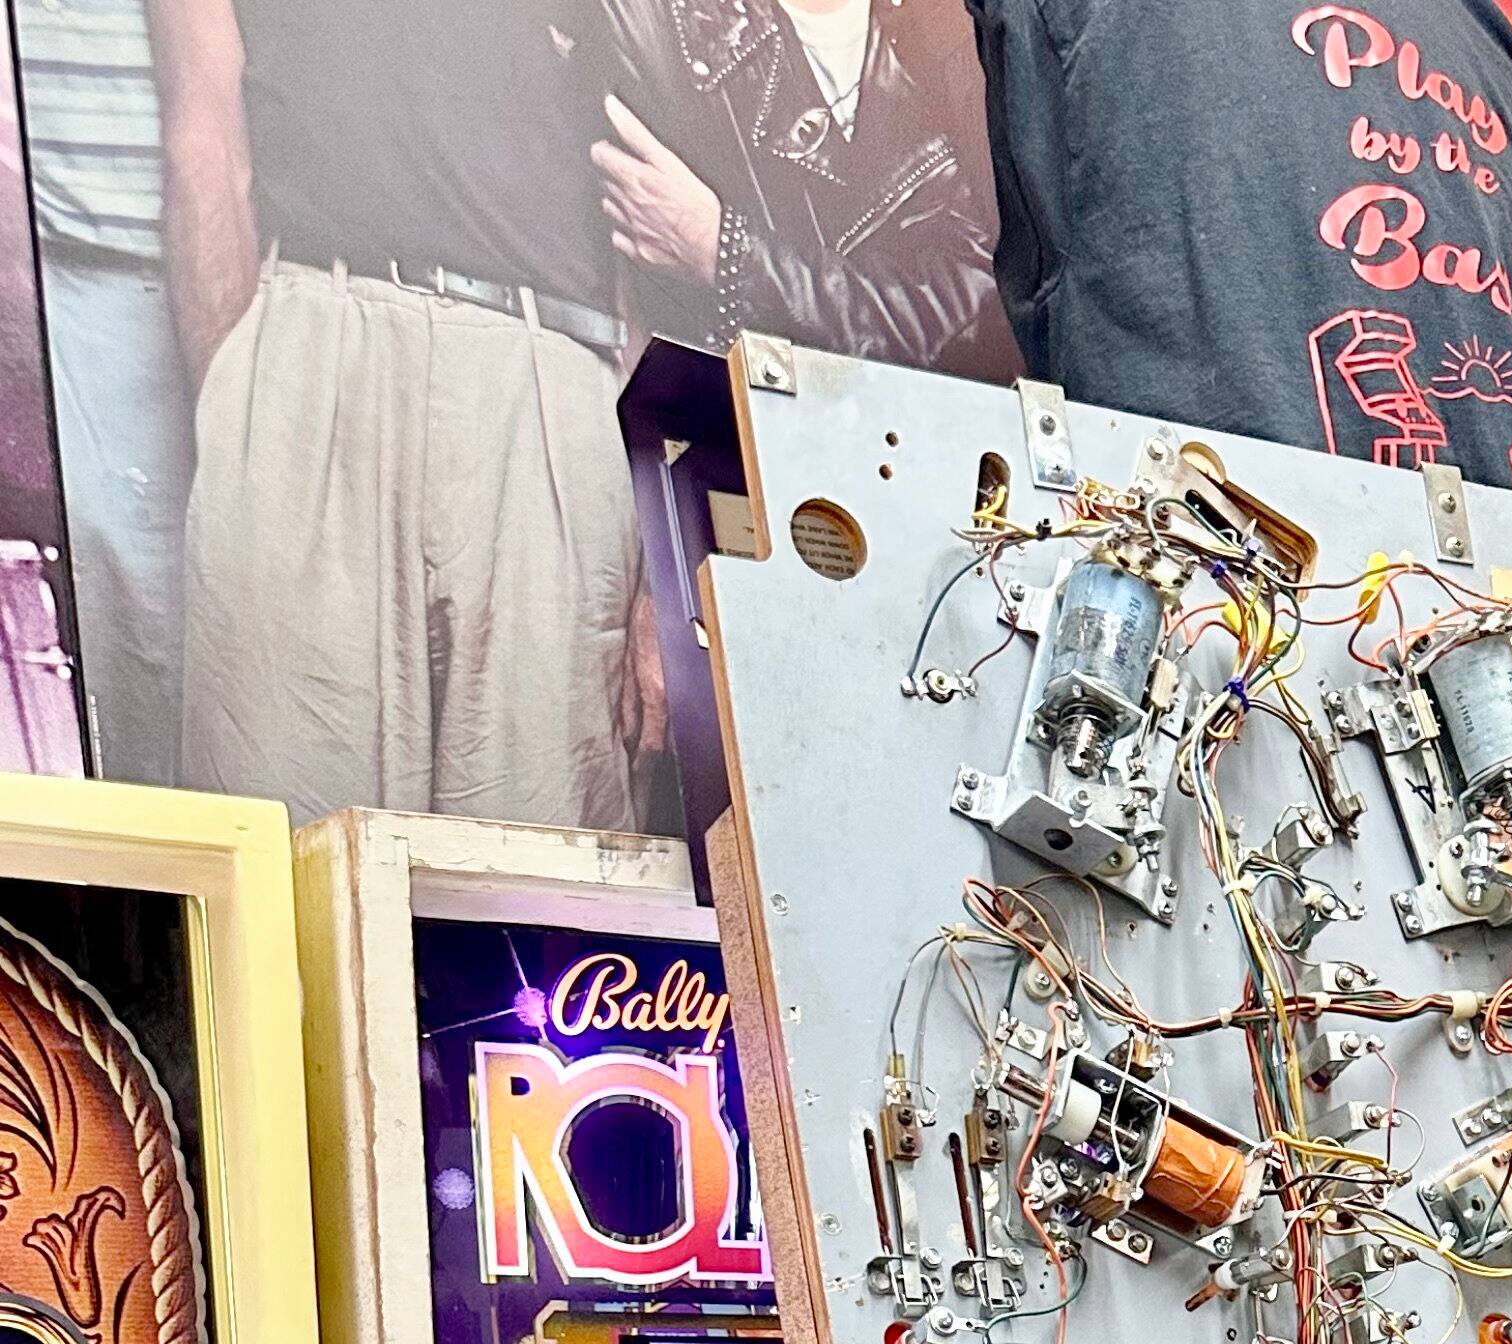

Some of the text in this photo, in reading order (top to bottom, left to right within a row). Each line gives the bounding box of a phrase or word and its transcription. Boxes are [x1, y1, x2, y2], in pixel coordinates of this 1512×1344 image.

[1291, 5, 1507, 155] Play
[1350, 115, 1500, 194] by the
[549, 953, 732, 1053] Bally
